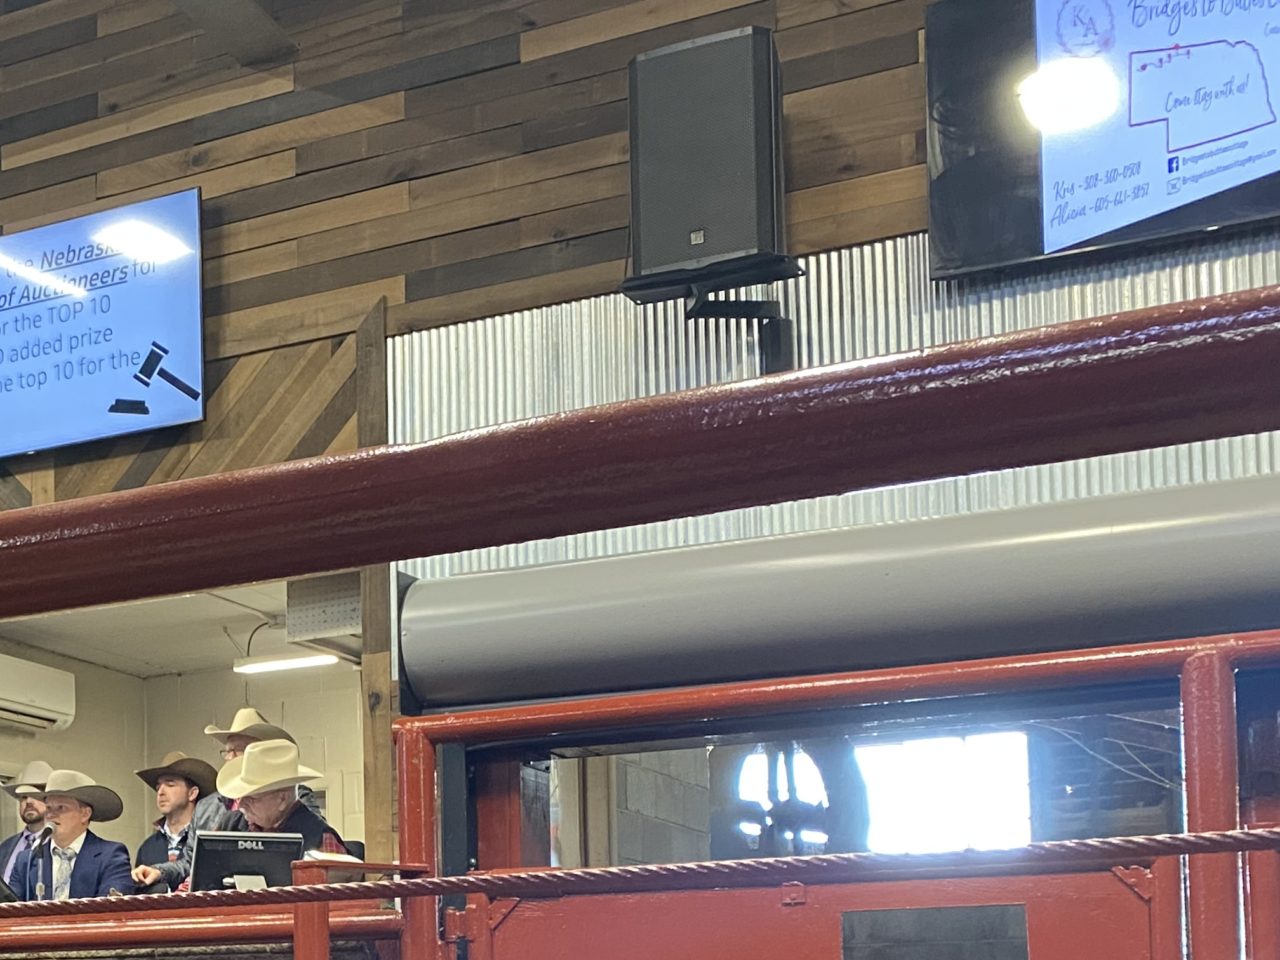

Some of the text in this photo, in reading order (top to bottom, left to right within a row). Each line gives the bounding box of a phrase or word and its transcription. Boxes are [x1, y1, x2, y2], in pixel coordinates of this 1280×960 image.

[40, 240, 123, 270] Nebras
[14, 312, 42, 333] the
[48, 301, 84, 325] TOP
[90, 294, 111, 316] 10
[10, 333, 63, 363] added
[69, 327, 113, 354] prize
[18, 370, 48, 391] top
[54, 361, 74, 381] 10
[79, 357, 105, 377] for
[111, 349, 141, 370] the
[237, 840, 265, 850] DELL
